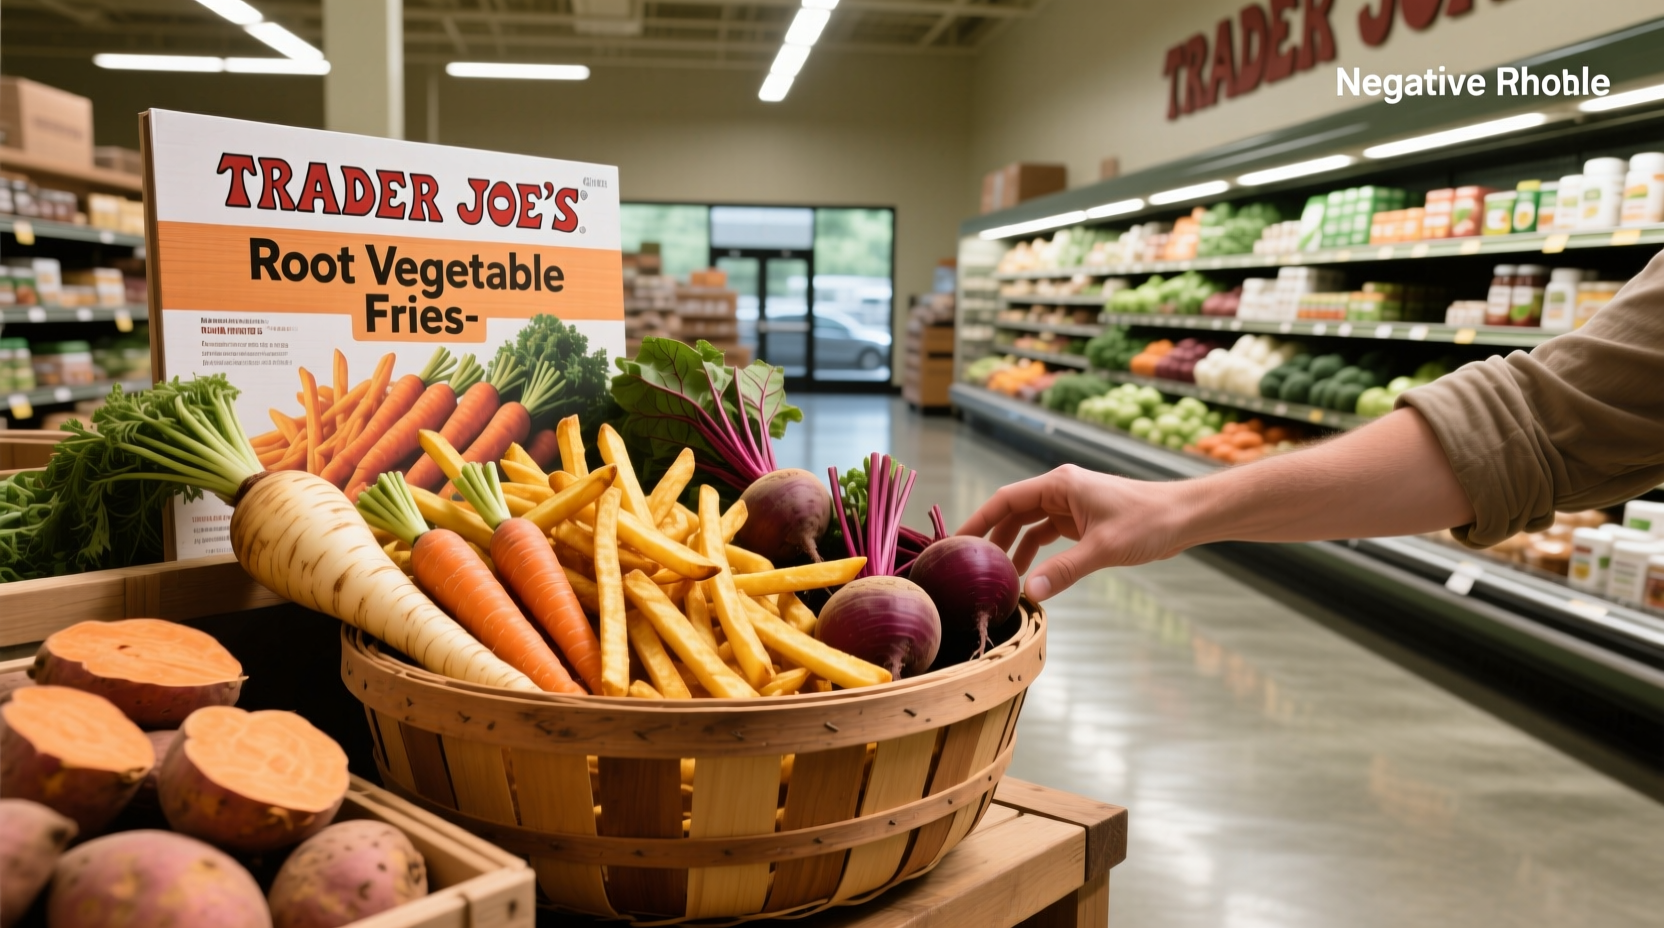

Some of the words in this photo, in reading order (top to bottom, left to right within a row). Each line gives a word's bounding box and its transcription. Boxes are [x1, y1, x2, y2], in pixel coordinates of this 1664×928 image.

[1163, 0, 1338, 122] TRADER
[216, 152, 443, 223] TRADER
[456, 177, 579, 234] JOE'S
[249, 237, 355, 284] Root
[364, 244, 565, 299] Vegetable
[365, 293, 479, 335] Fries-
